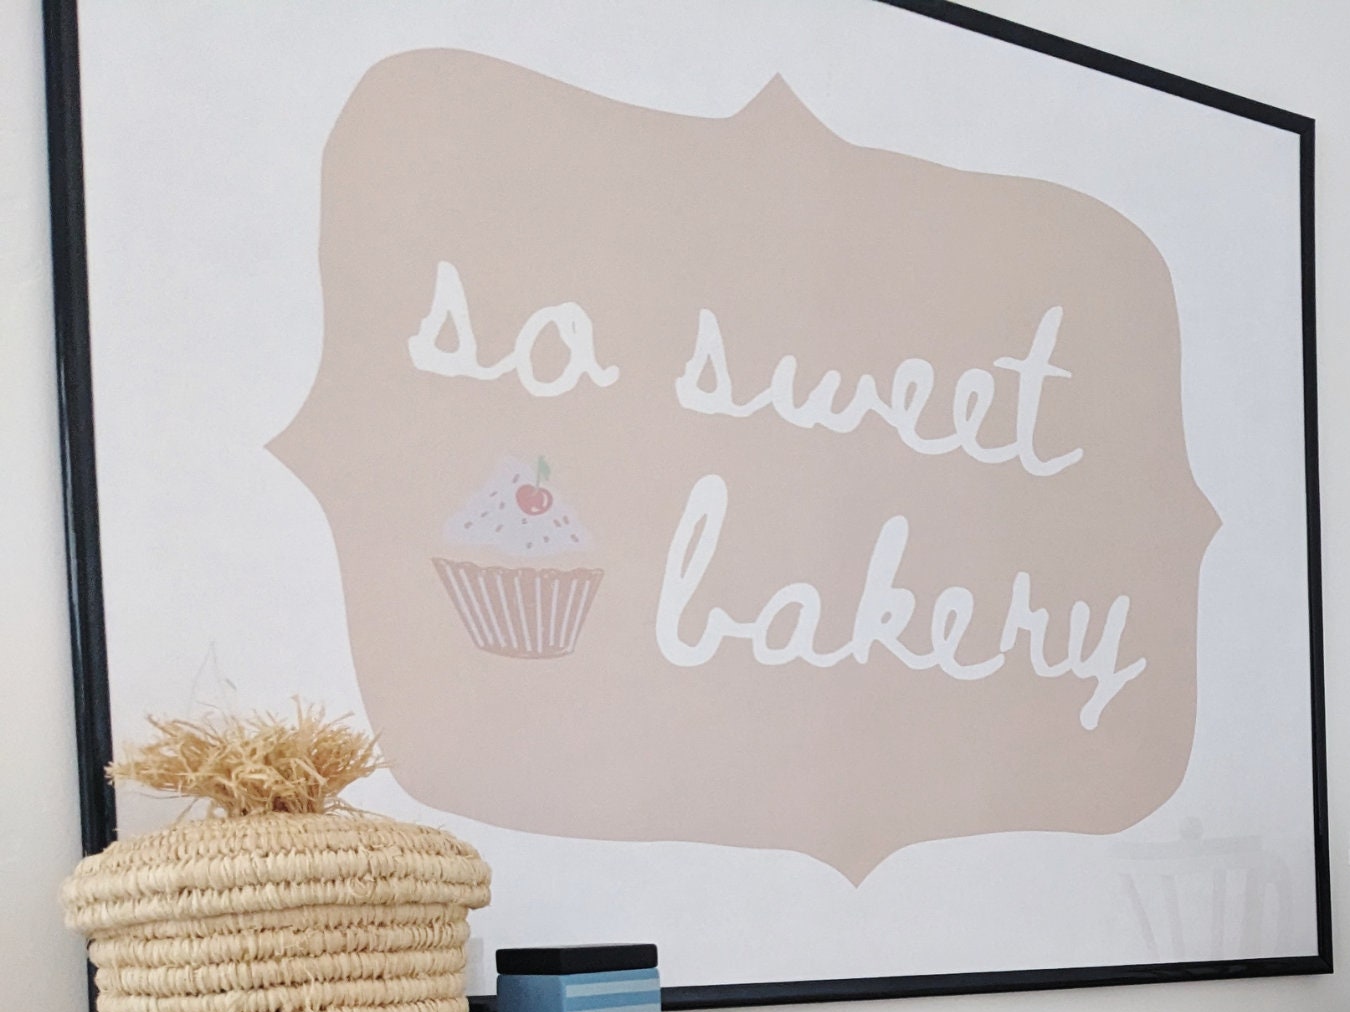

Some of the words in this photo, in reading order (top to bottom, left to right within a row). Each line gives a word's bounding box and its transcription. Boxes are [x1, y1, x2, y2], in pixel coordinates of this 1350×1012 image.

[408, 260, 619, 396] so
[675, 305, 1084, 476] sweet
[655, 474, 1147, 730] bakery
